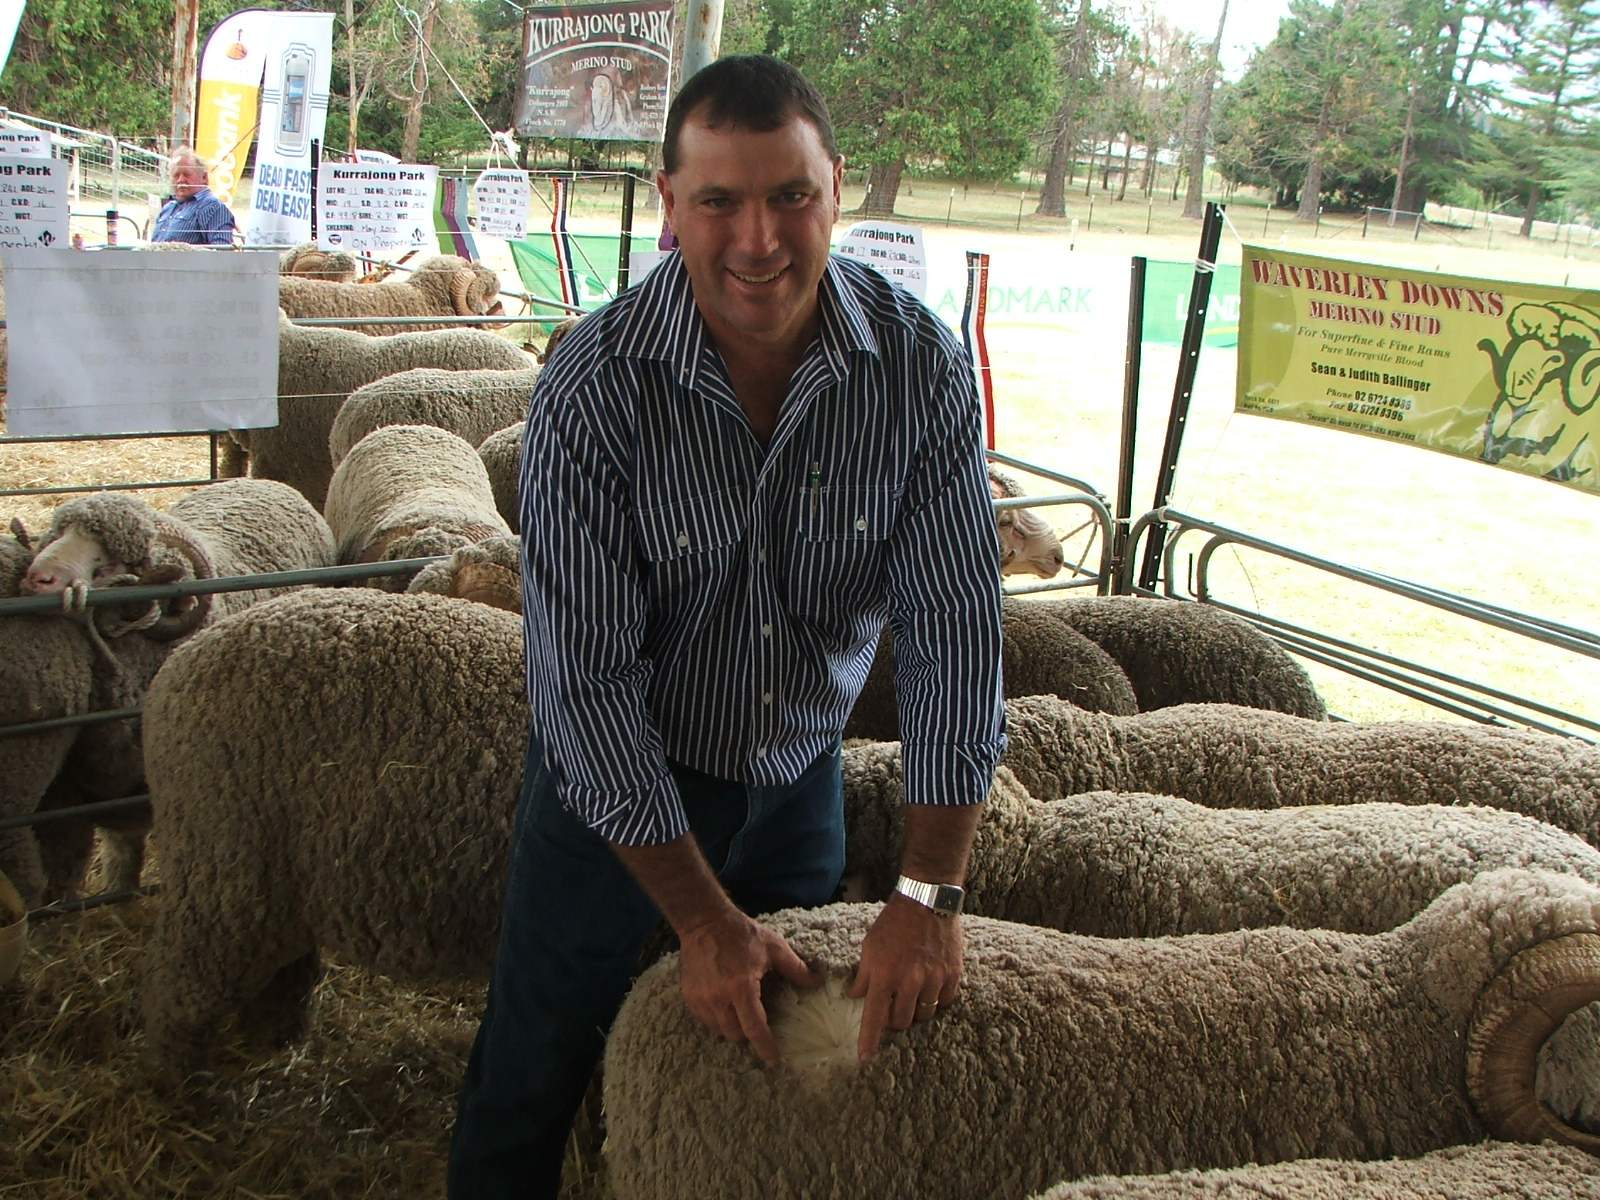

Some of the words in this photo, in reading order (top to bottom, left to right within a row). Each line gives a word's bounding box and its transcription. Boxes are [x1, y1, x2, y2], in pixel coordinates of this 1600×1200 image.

[528, 14, 626, 56] KURRAJONG
[629, 10, 672, 50] PARK
[572, 57, 608, 71] MERINO
[611, 57, 632, 71] STUD
[17, 134, 40, 142] Park
[16, 164, 52, 176] Park
[259, 163, 283, 188] DEAD
[333, 169, 397, 181] Kurrajong
[398, 170, 426, 181] Park
[255, 188, 281, 214] DEAD
[895, 231, 916, 246] Park
[936, 286, 1093, 313] ADMARK
[1251, 258, 1389, 301] WAVERLEY
[1400, 279, 1505, 317] DOWNS
[1309, 301, 1385, 327] MERINO
[1390, 312, 1441, 336] STUD
[1297, 326, 1318, 338] For
[1320, 328, 1374, 347] Superfine
[1376, 338, 1387, 349] &
[1388, 339, 1415, 353] Fine
[1416, 343, 1451, 359] Rams
[1320, 343, 1345, 355] Pure
[1395, 355, 1424, 368] Blood
[1311, 361, 1337, 376] Sean
[1339, 367, 1346, 378] &
[1348, 367, 1381, 383] Judith
[1382, 373, 1431, 392] Ballinger
[1326, 387, 1353, 399] Phone
[1355, 390, 1366, 401] 02
[1347, 402, 1359, 413] 02
